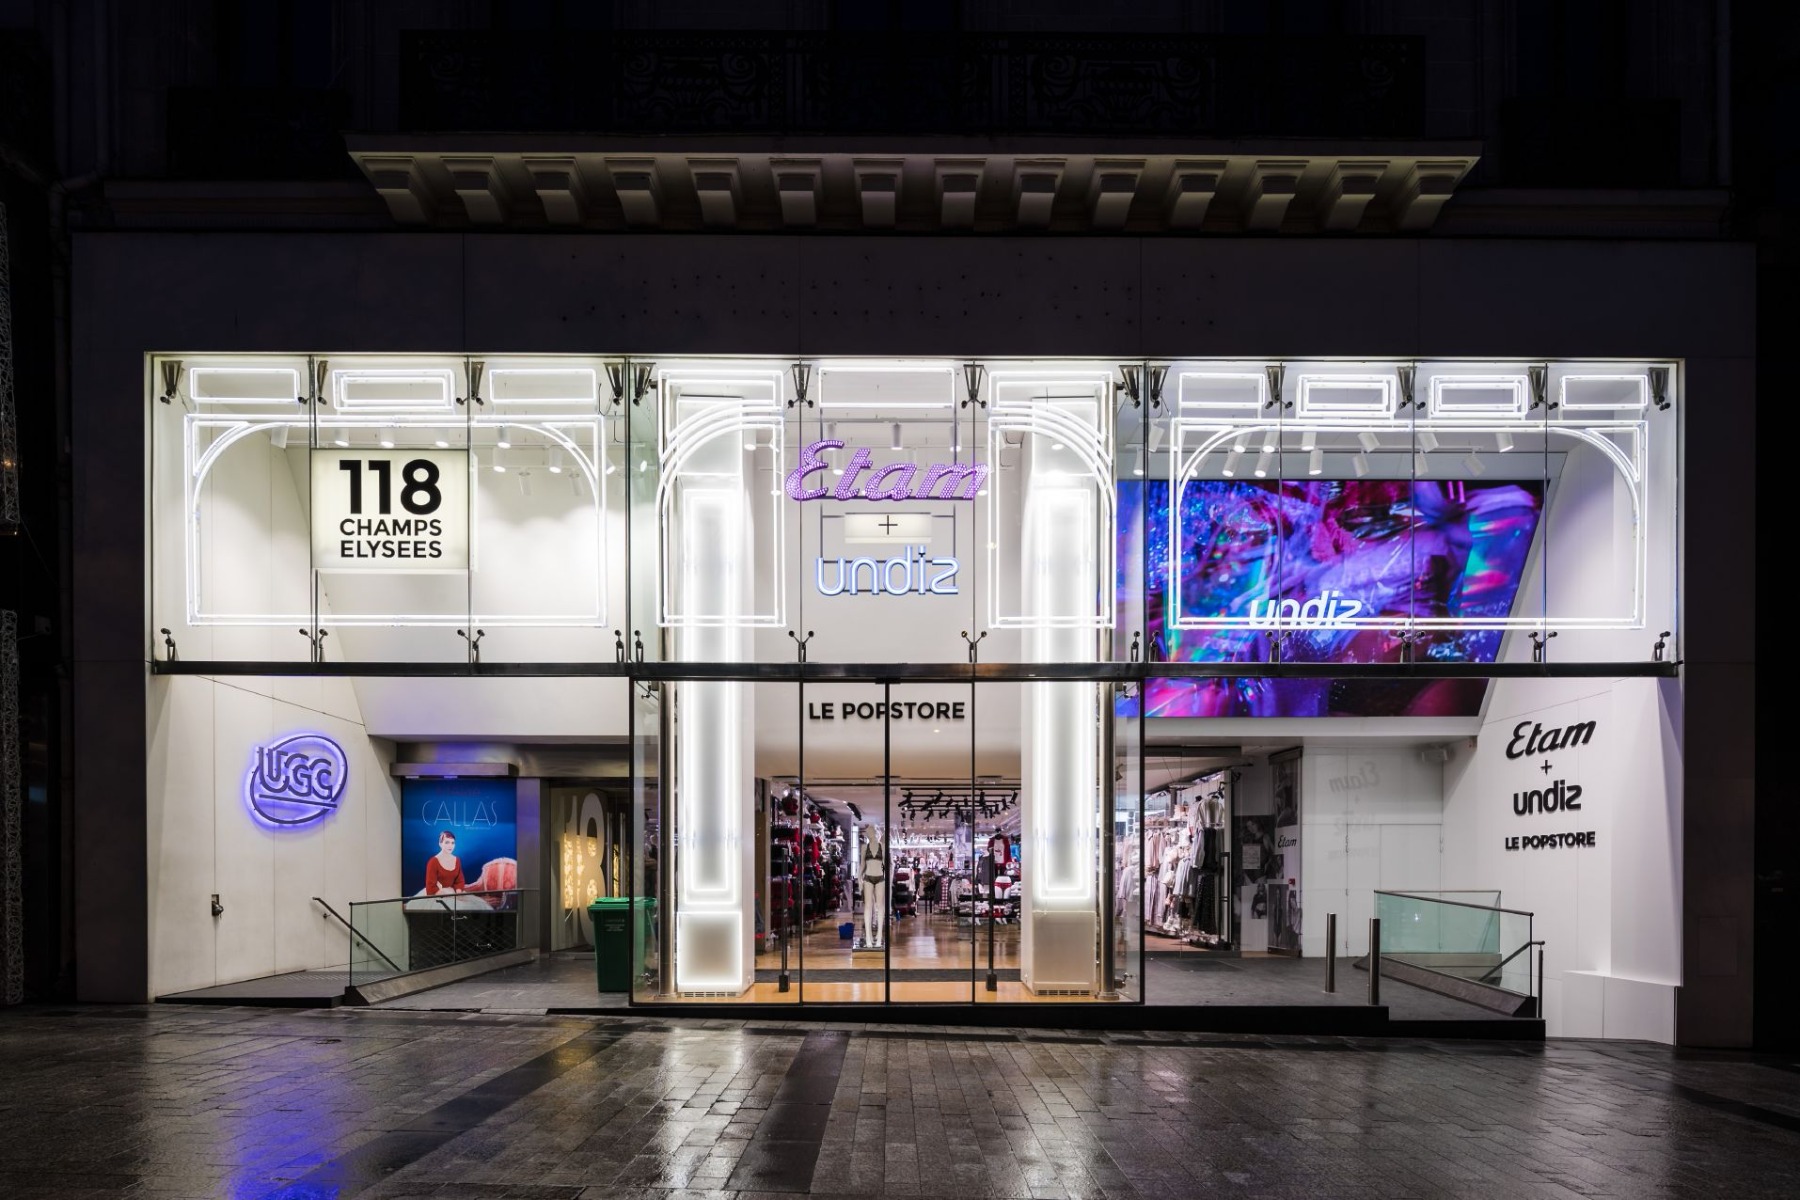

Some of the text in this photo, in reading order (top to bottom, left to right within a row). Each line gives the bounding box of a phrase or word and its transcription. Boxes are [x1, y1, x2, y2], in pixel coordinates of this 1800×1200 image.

[339, 459, 442, 515] 118
[785, 439, 988, 501] Etam
[340, 518, 442, 536] CHAMPS
[341, 540, 442, 558] ELYSEES
[816, 545, 959, 596] undiz
[1250, 590, 1363, 627] undiz
[809, 702, 965, 720] LE POPSTORE
[1505, 720, 1597, 760] Etam
[258, 746, 334, 800] UGC
[421, 799, 498, 827] CALLAS
[1513, 779, 1583, 817] undiz
[1505, 831, 1596, 851] LE POPSTORE
